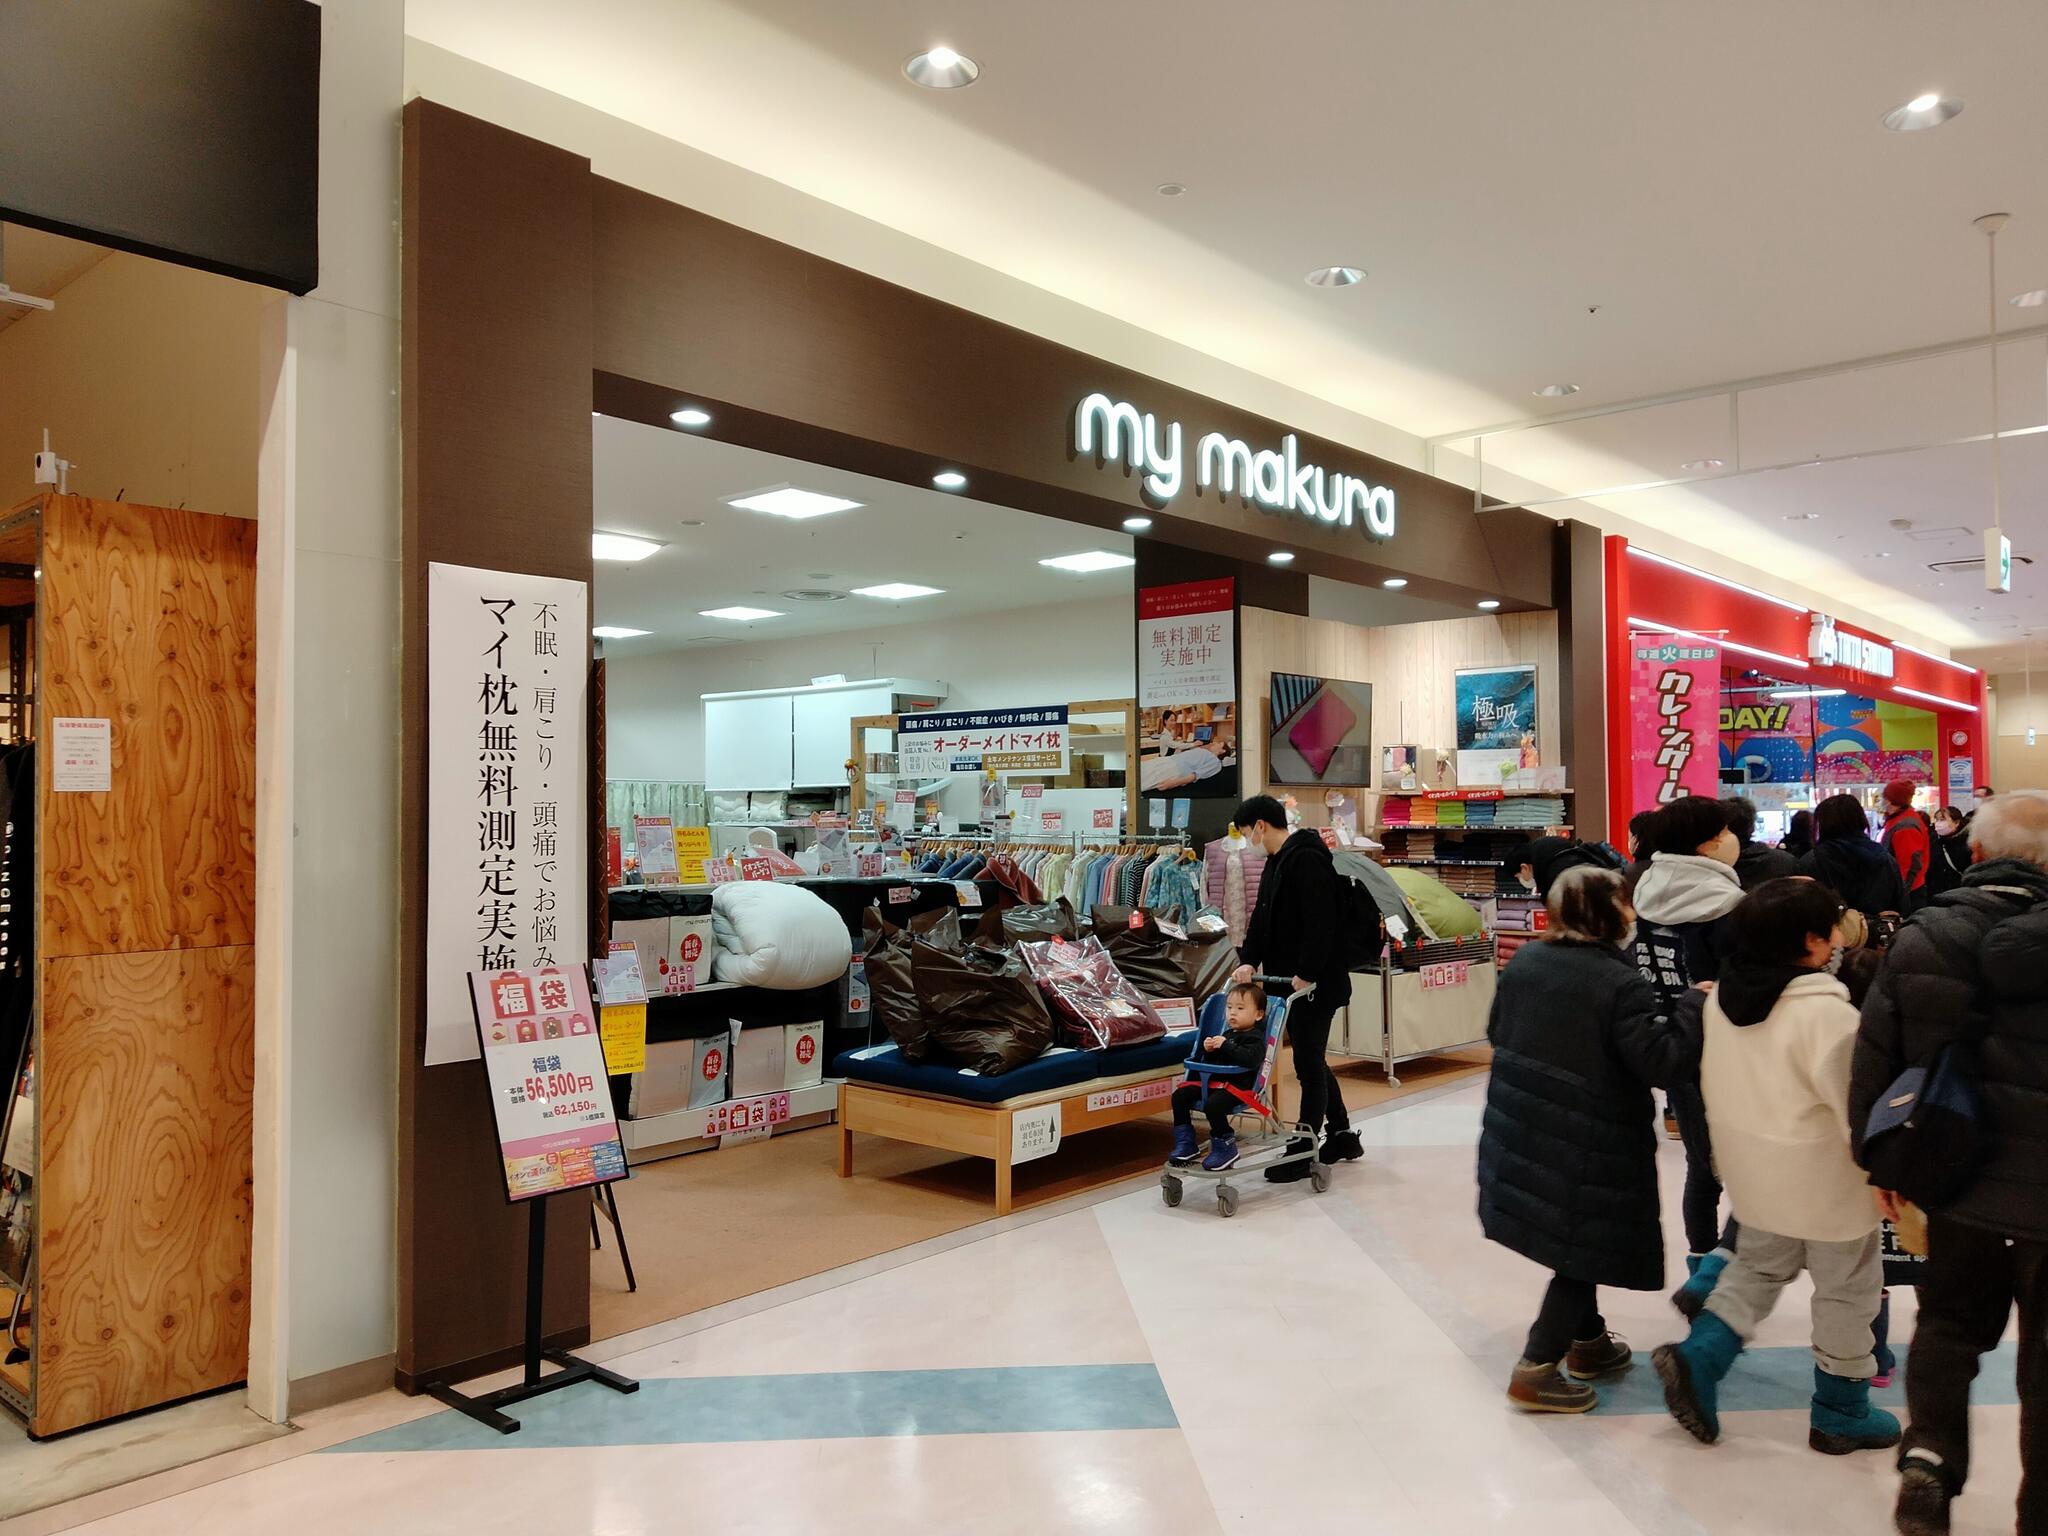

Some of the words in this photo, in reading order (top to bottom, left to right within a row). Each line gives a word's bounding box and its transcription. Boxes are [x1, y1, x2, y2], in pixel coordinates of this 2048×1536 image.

[1074, 392, 1181, 498] my
[1196, 432, 1394, 536] makura
[1152, 623, 1221, 649] 無料測定
[1160, 645, 1212, 667] 実施中
[1472, 695, 1520, 729] 極吸
[933, 731, 1061, 753] オーダーメイドマイ枕
[1657, 671, 1692, 803] クレーンゲーム
[531, 602, 558, 967] 不眠・肩こり・頭痛でお悩み
[498, 979, 569, 1016] 福袋
[531, 1055, 562, 1074] 福袋
[525, 1071, 594, 1104] 56,500円
